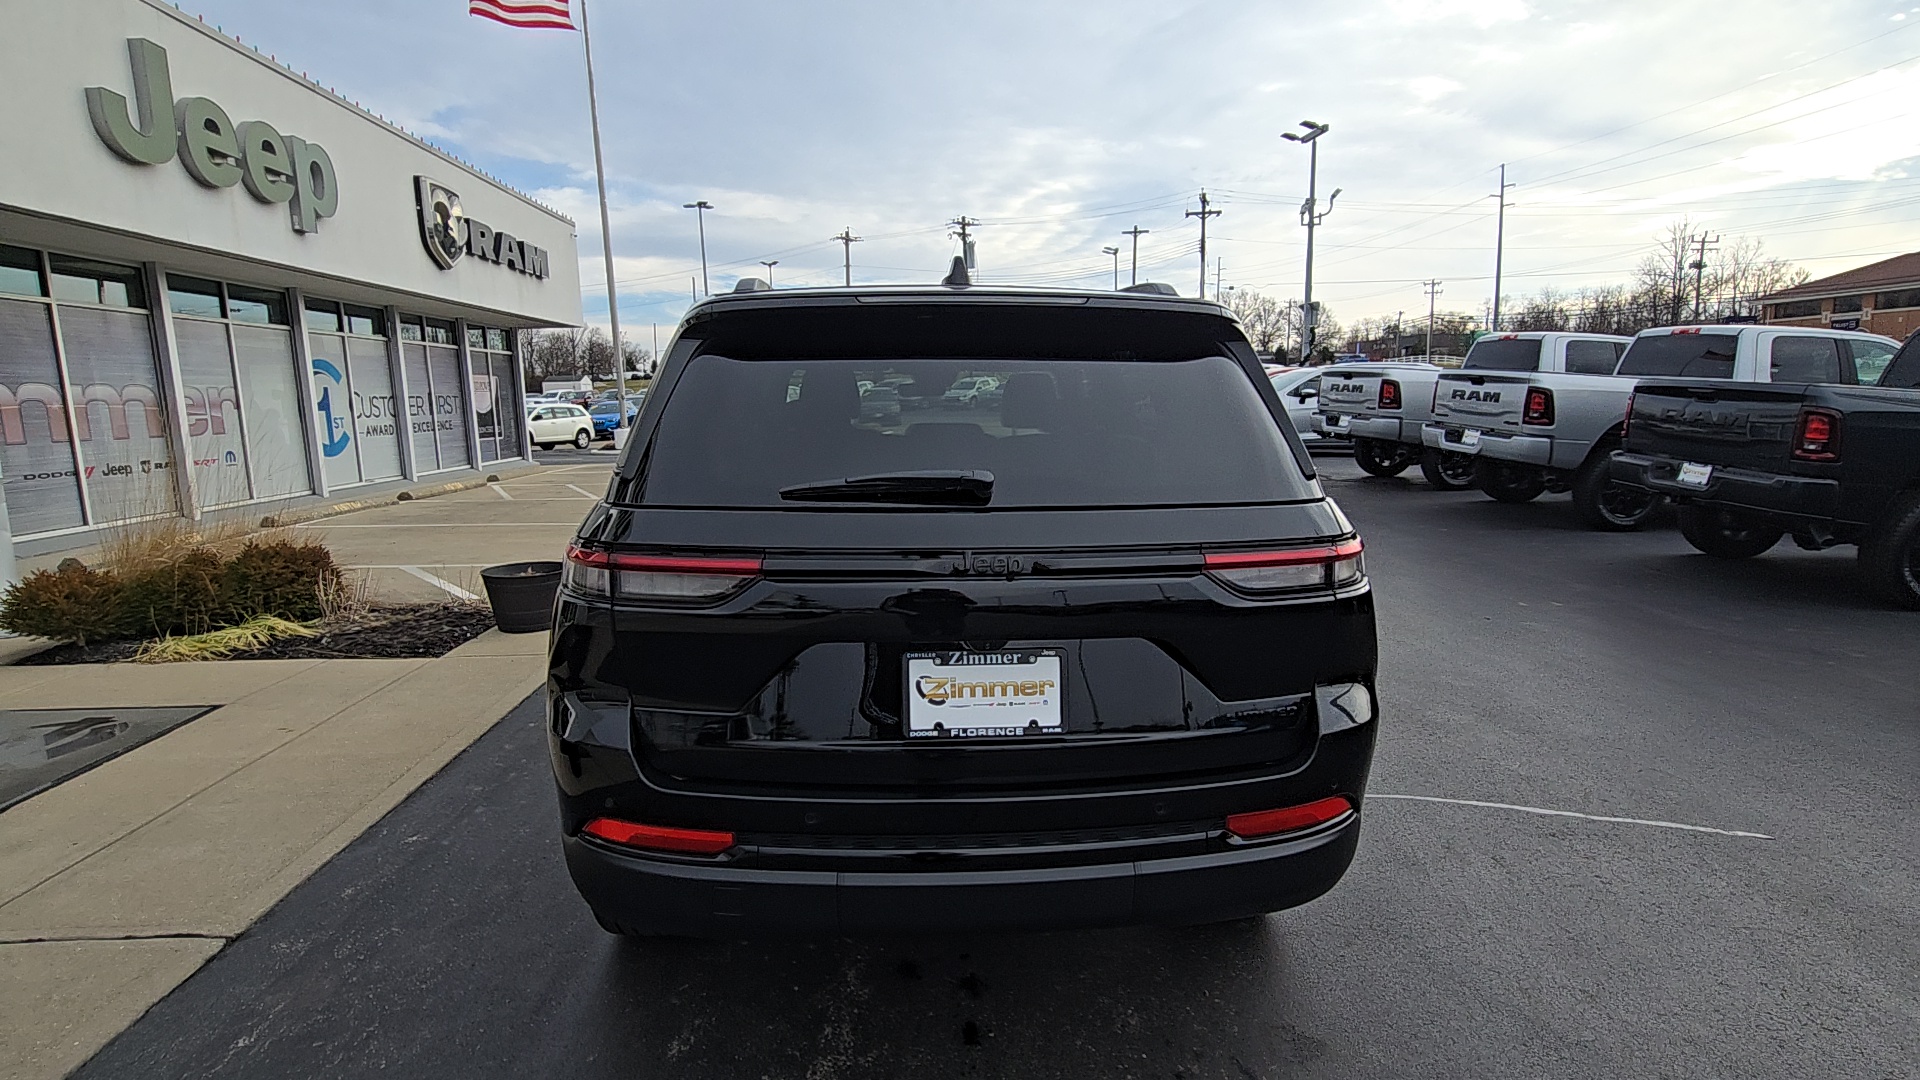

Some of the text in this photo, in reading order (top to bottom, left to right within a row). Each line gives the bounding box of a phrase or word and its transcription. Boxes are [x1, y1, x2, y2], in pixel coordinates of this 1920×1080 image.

[84, 37, 338, 234] Jeep
[464, 217, 550, 280] RAM
[1330, 383, 1364, 394] RAM
[1451, 388, 1501, 403] RAM
[350, 390, 426, 419] CUSTOER
[1660, 408, 1750, 427] RAM
[365, 419, 454, 437] AWARD EXCELENCE
[23, 470, 78, 481] DODG
[102, 462, 132, 477] Jeep
[154, 461, 173, 470] RA
[952, 551, 1025, 581] Jeep
[949, 651, 1022, 665] Zimmer
[924, 677, 1056, 701] Zimmer
[950, 728, 1025, 738] FLORENCE
